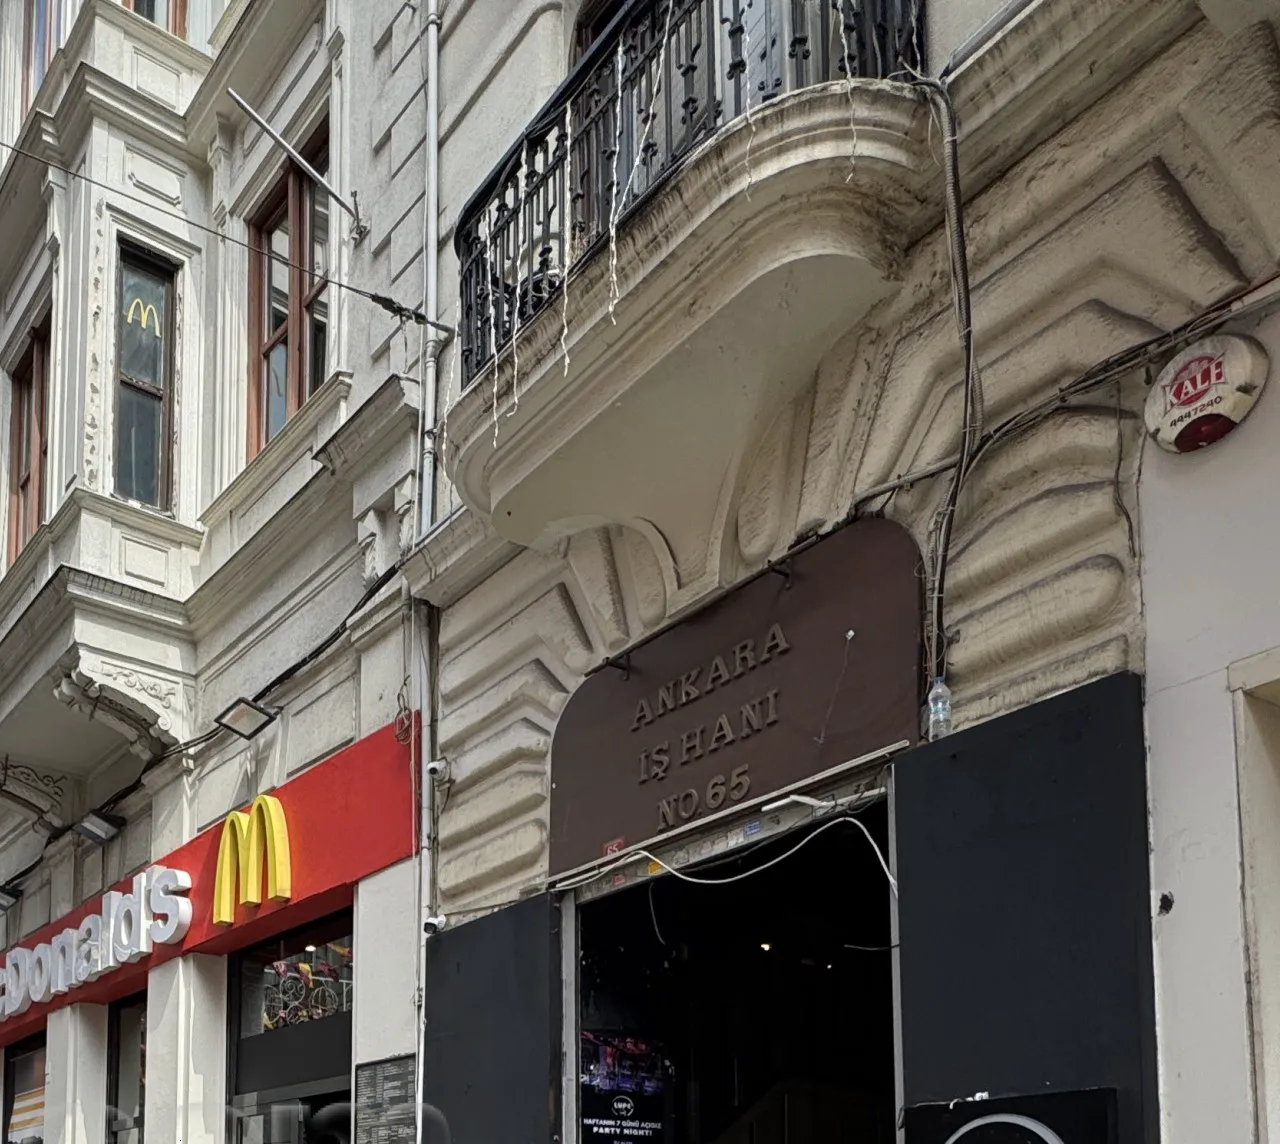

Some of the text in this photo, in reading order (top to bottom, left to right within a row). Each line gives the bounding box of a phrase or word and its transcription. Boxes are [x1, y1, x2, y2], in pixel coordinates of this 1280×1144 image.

[1163, 353, 1228, 417] KALE
[629, 622, 792, 732] ANKARA
[680, 688, 780, 765] HANI
[593, 1127, 621, 1135] PARTY
